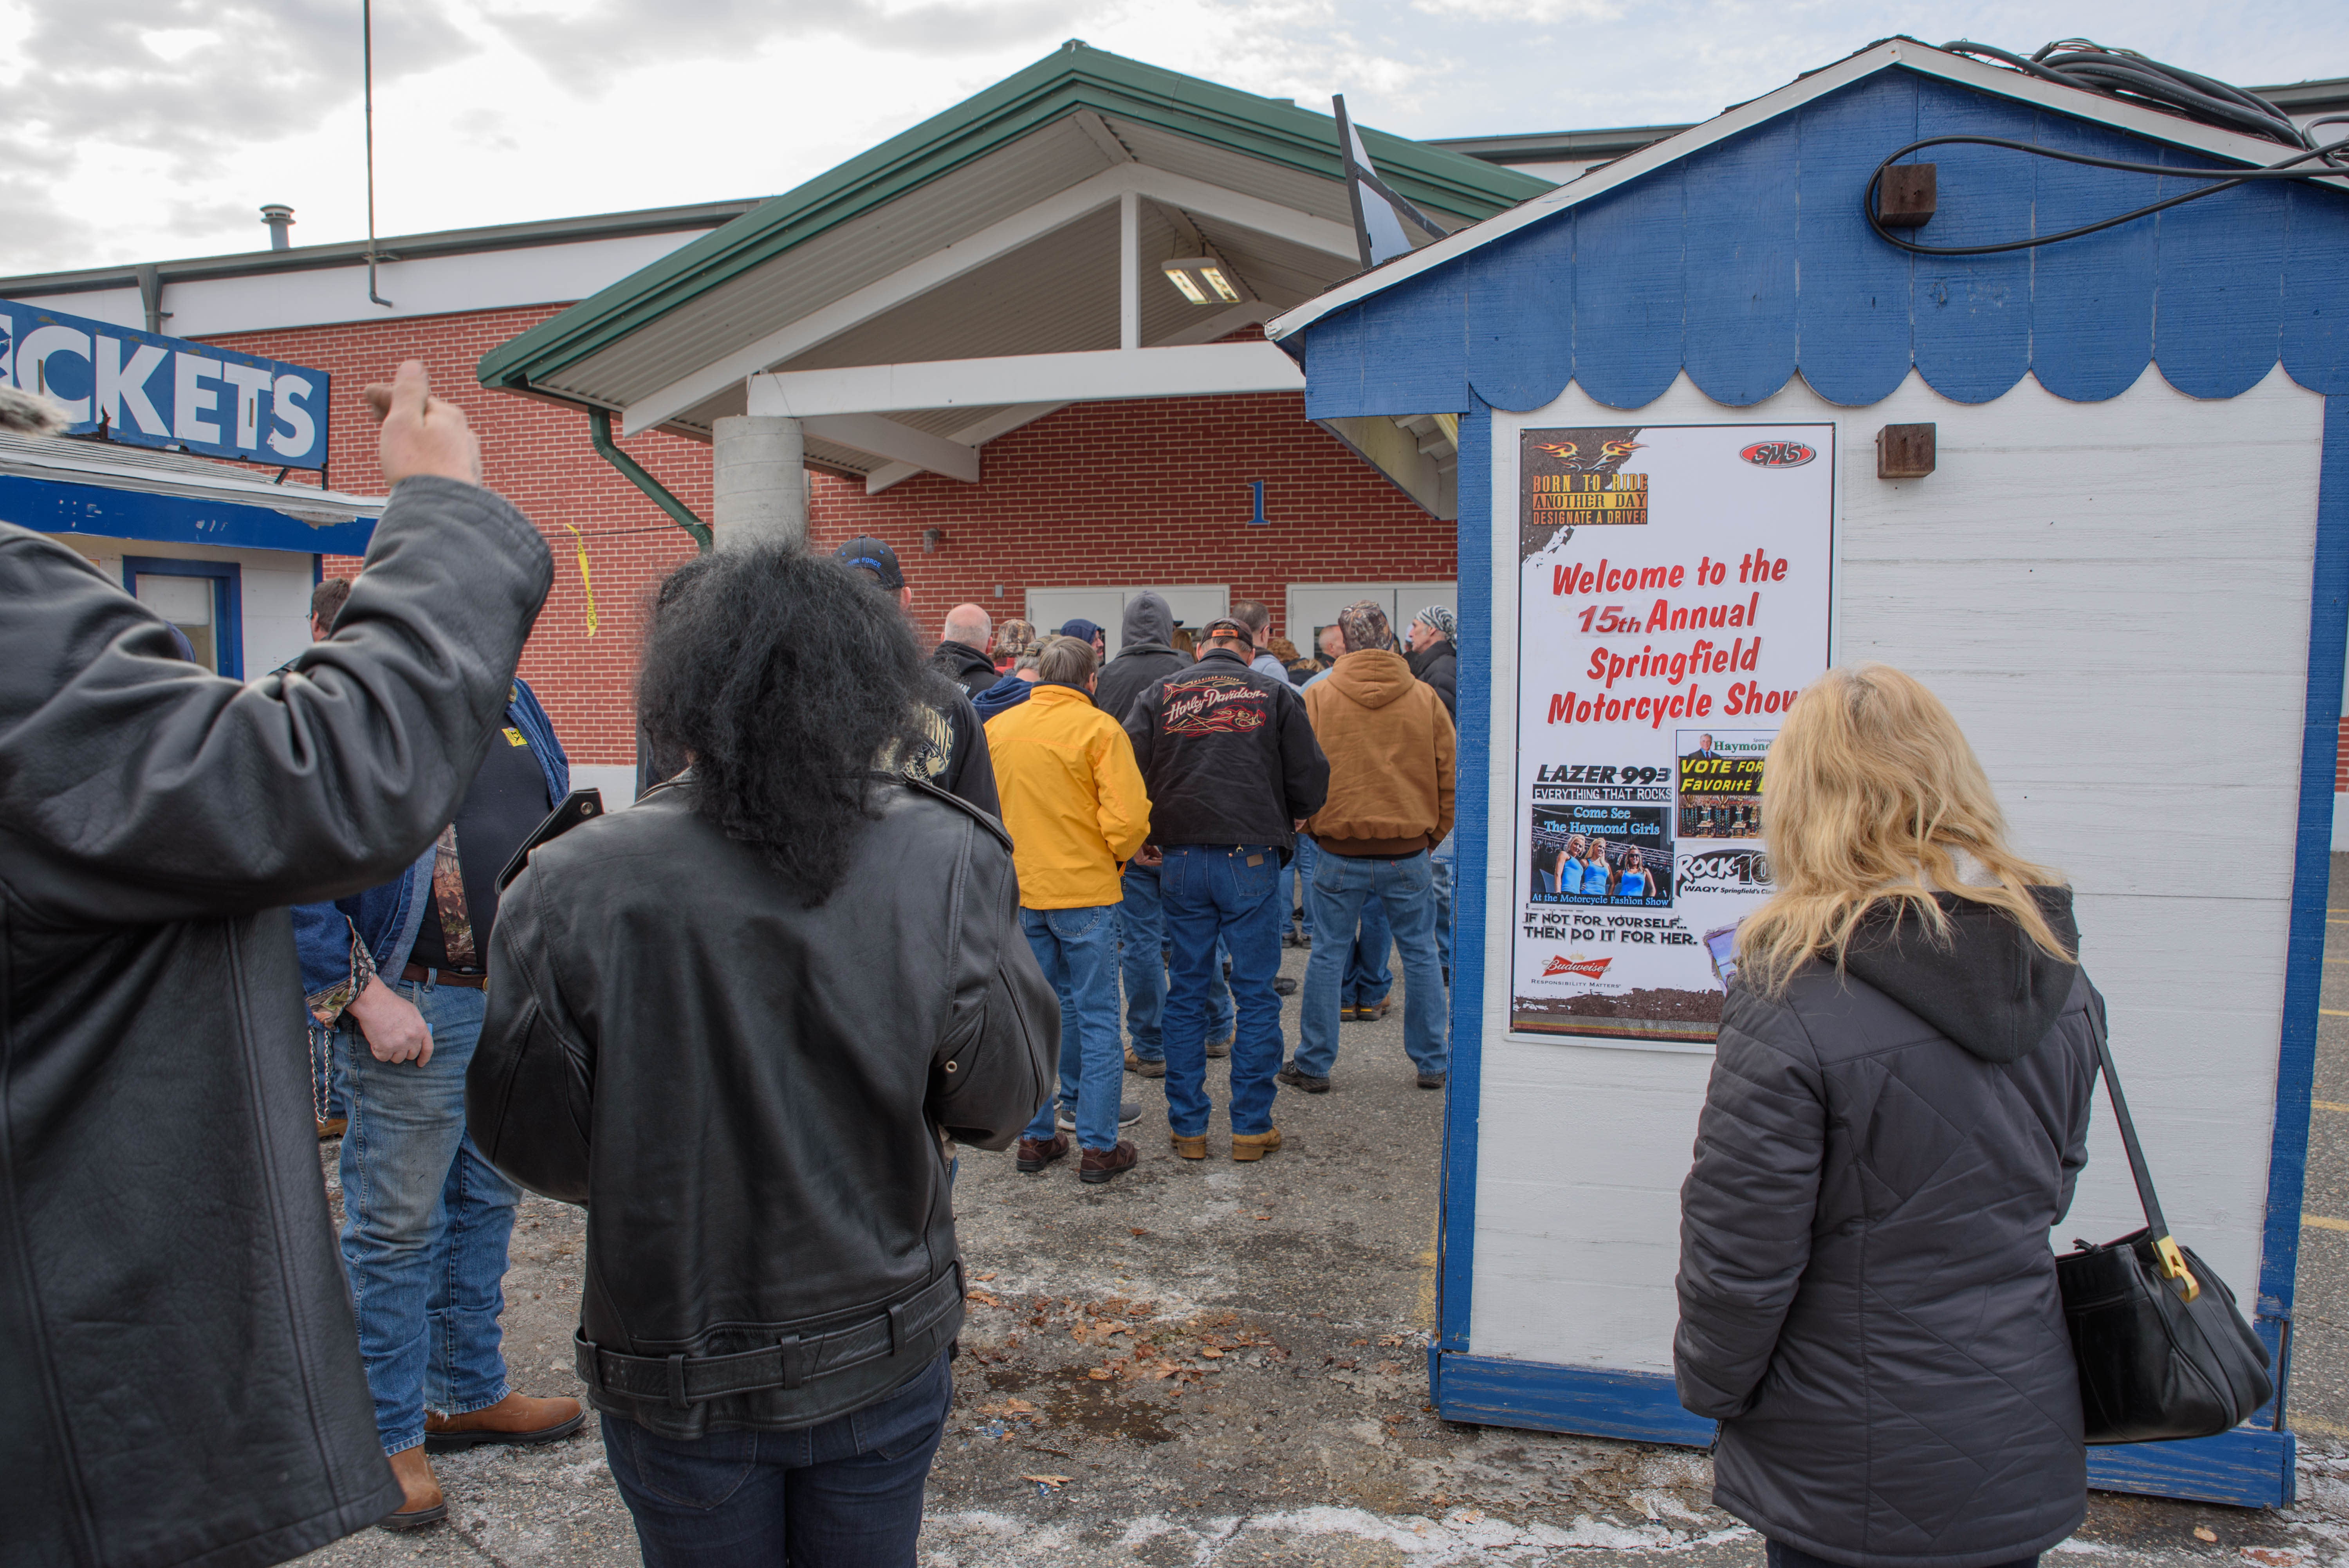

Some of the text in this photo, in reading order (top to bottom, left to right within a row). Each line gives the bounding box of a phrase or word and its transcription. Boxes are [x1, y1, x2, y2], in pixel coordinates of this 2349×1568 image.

[1751, 442, 1804, 465] SMS
[1533, 473, 1648, 492] BORN TO RIDE
[1247, 479, 1270, 525] 1
[1534, 493, 1646, 508] ANOTHER DAY
[1533, 510, 1647, 525] DESIGNATE A DRIVER
[862, 557, 882, 568] FORCE
[1553, 548, 1788, 596] Welcome to the
[1577, 591, 1760, 633] 15th Annual
[1587, 636, 1761, 689] Springfield
[1547, 684, 1712, 729] Motorcycle
[1537, 765, 1617, 784] LAZER
[1681, 759, 1764, 773] VOTE FOR
[1534, 788, 1672, 800] EVERYTHING THAT ROCKS
[1573, 807, 1631, 819] Come See
[1544, 821, 1660, 836] The Haymond Girls
[1676, 854, 1735, 882] ROCK
[1560, 895, 1607, 905] Motorcycle
[1610, 896, 1642, 905] Fashion
[1525, 911, 1687, 929] IF NOT FOR YOURSELF...
[1524, 926, 1698, 945] THEN DO IT FOR HER.
[1541, 959, 1611, 973] Budweiser
